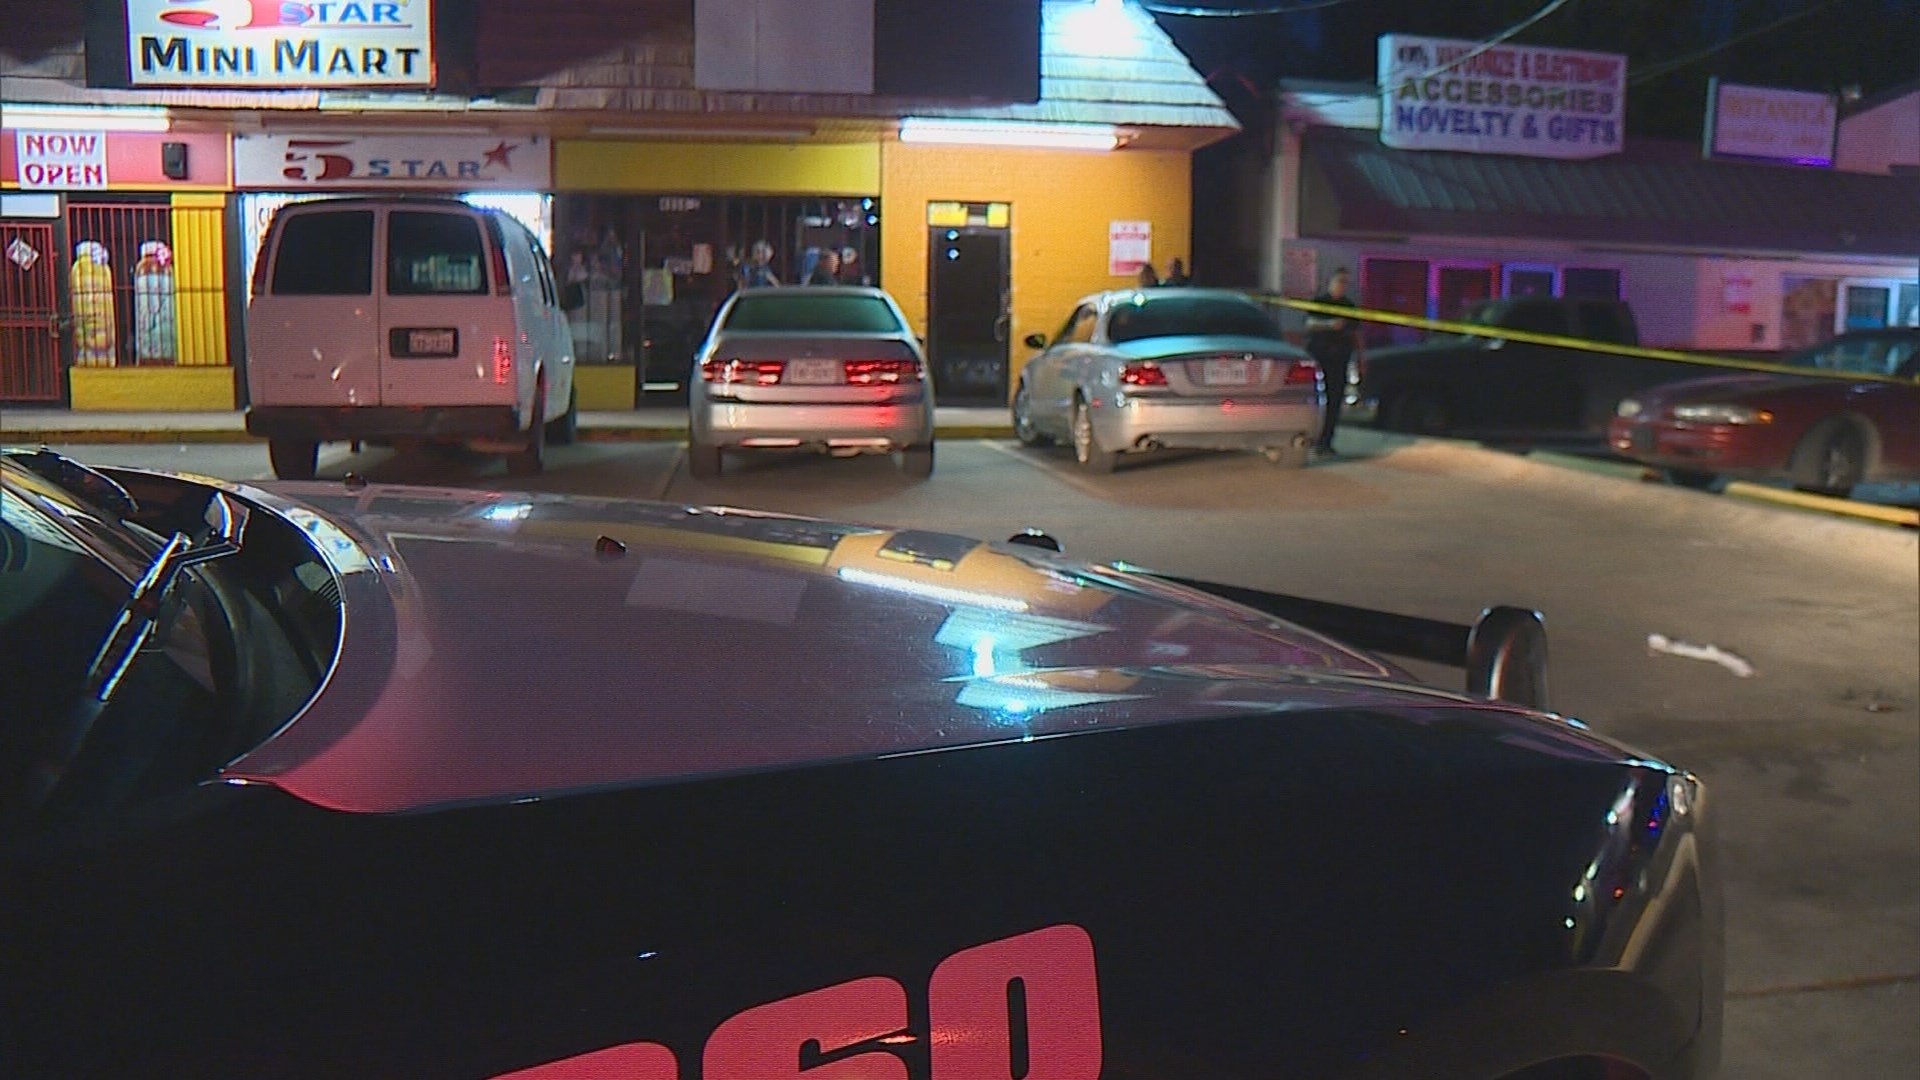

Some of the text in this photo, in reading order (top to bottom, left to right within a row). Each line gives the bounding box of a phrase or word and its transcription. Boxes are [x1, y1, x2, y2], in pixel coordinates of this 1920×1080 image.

[280, 0, 401, 23] STAR
[141, 36, 420, 75] MINI MART
[1399, 77, 1614, 114] ACCESSORIES
[1397, 105, 1616, 146] NOVELTY & GIFTS
[26, 134, 97, 156] NOW
[282, 140, 484, 180] 5 STAR
[24, 163, 103, 186] OPEN
